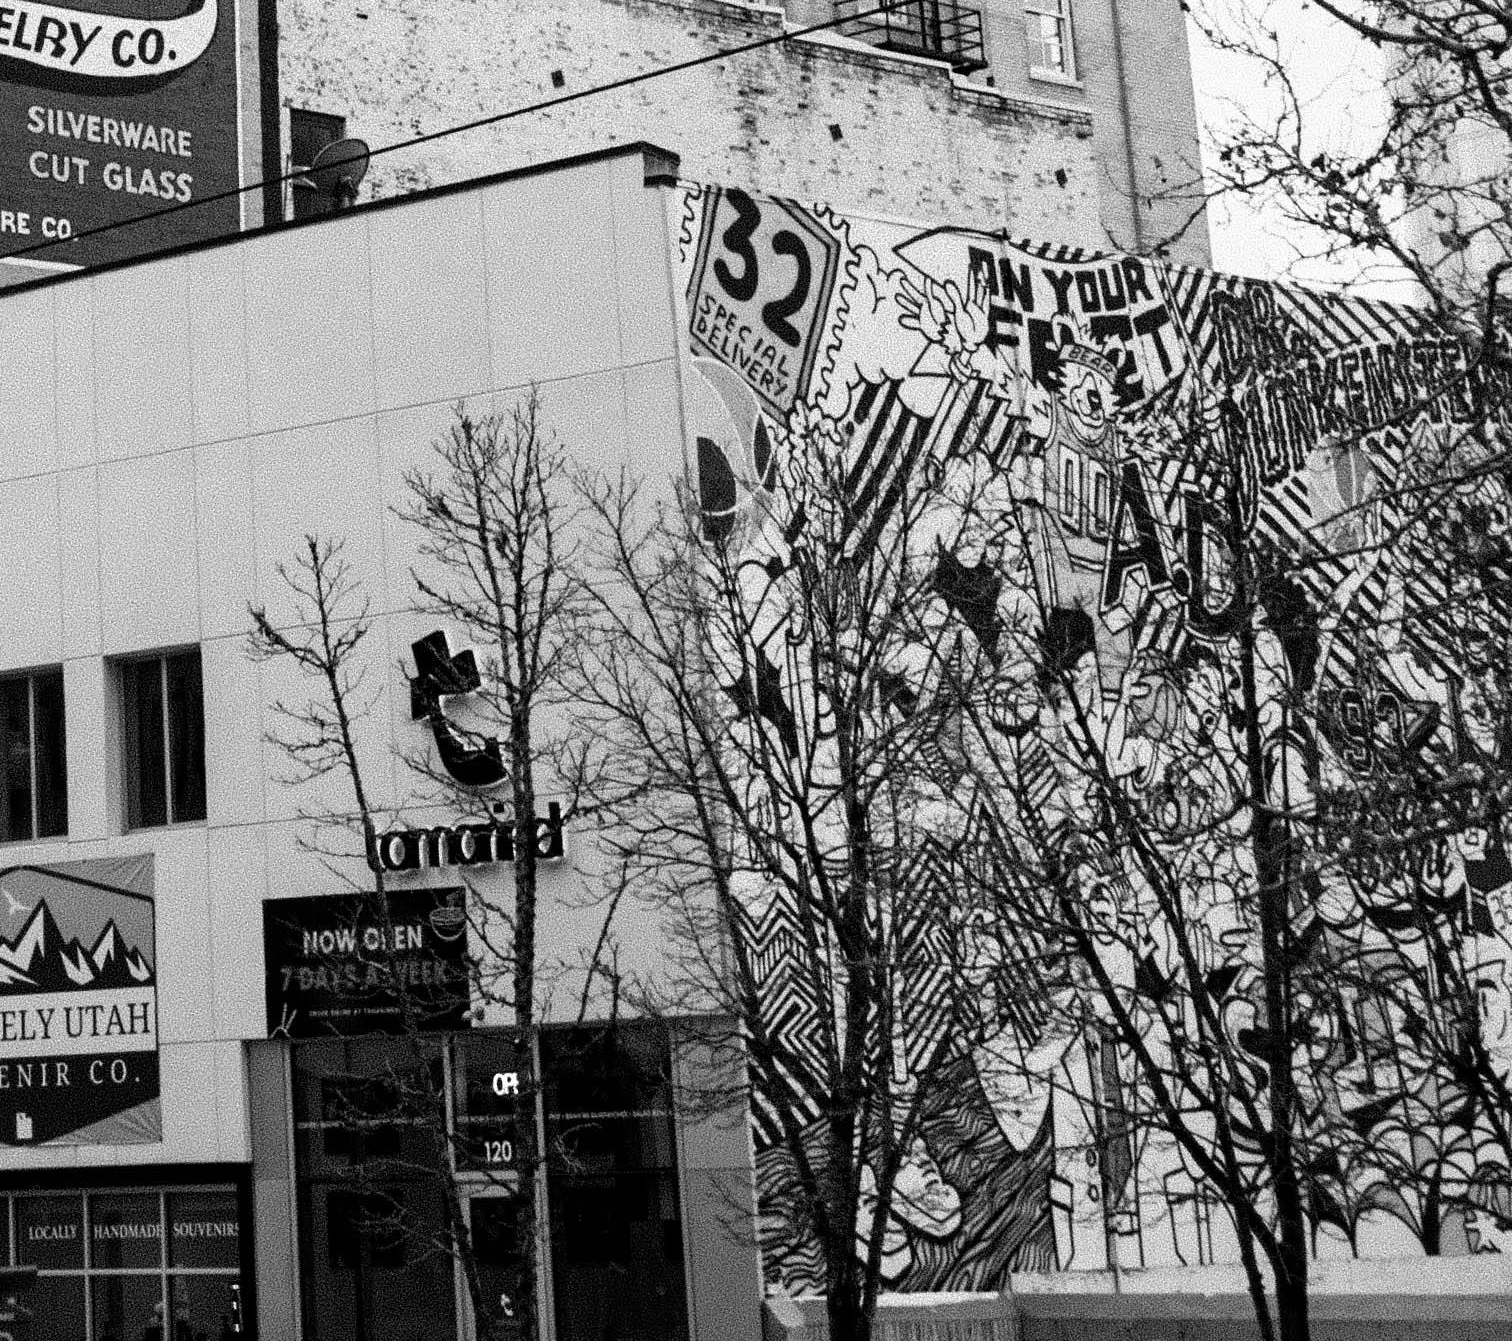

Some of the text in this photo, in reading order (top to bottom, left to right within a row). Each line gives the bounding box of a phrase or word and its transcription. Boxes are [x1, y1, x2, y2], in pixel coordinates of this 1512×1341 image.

[110, 26, 179, 69] CO.
[27, 105, 193, 158] SILVERWARE
[28, 151, 194, 204] CUT GLASS
[714, 186, 812, 349] 32
[1040, 255, 1155, 316] YOUR
[696, 315, 789, 397] DELIVERY
[698, 293, 790, 378] SPECIAL
[303, 927, 356, 956] NOW
[280, 965, 293, 992] 7
[62, 1001, 151, 1039] UTAH
[88, 1059, 140, 1086] CO.
[483, 1138, 514, 1163] 120
[28, 1223, 78, 1241] LOCALLY
